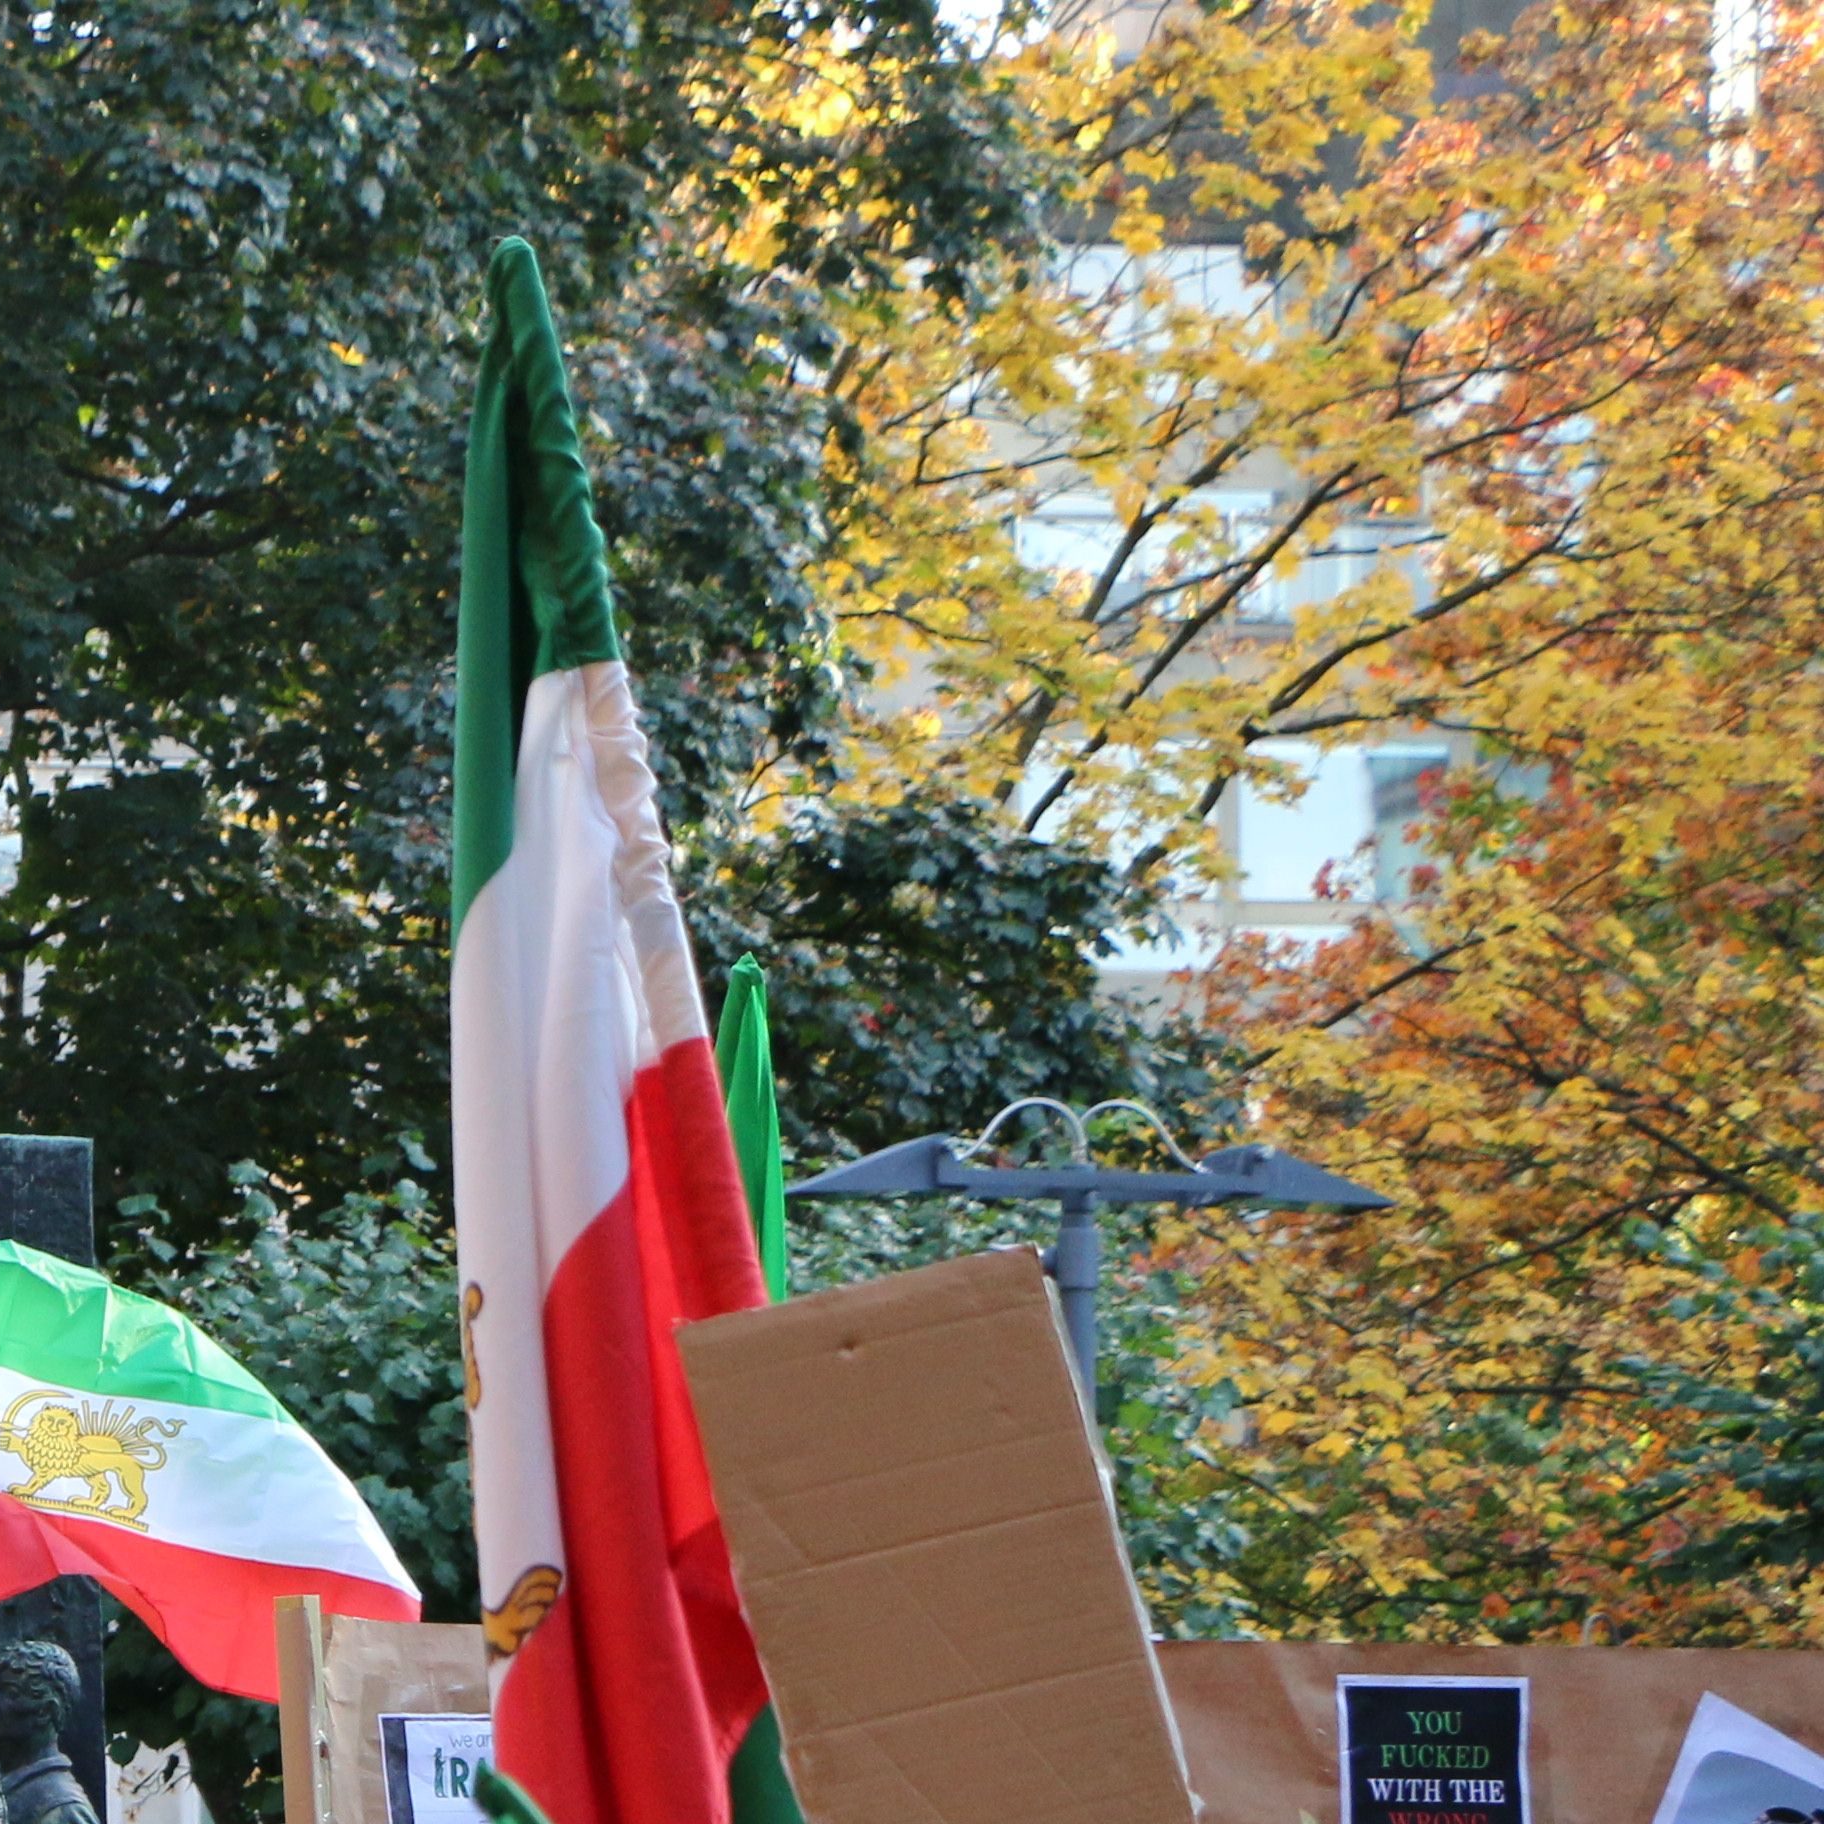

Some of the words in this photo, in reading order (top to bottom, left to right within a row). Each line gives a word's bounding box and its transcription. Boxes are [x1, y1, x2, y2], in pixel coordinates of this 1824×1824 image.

[1406, 1711, 1463, 1734] YOU
[476, 1735, 492, 1747] ar
[1381, 1744, 1490, 1768] FUCKED
[1367, 1778, 1442, 1802] WITH
[1449, 1779, 1505, 1803] THE
